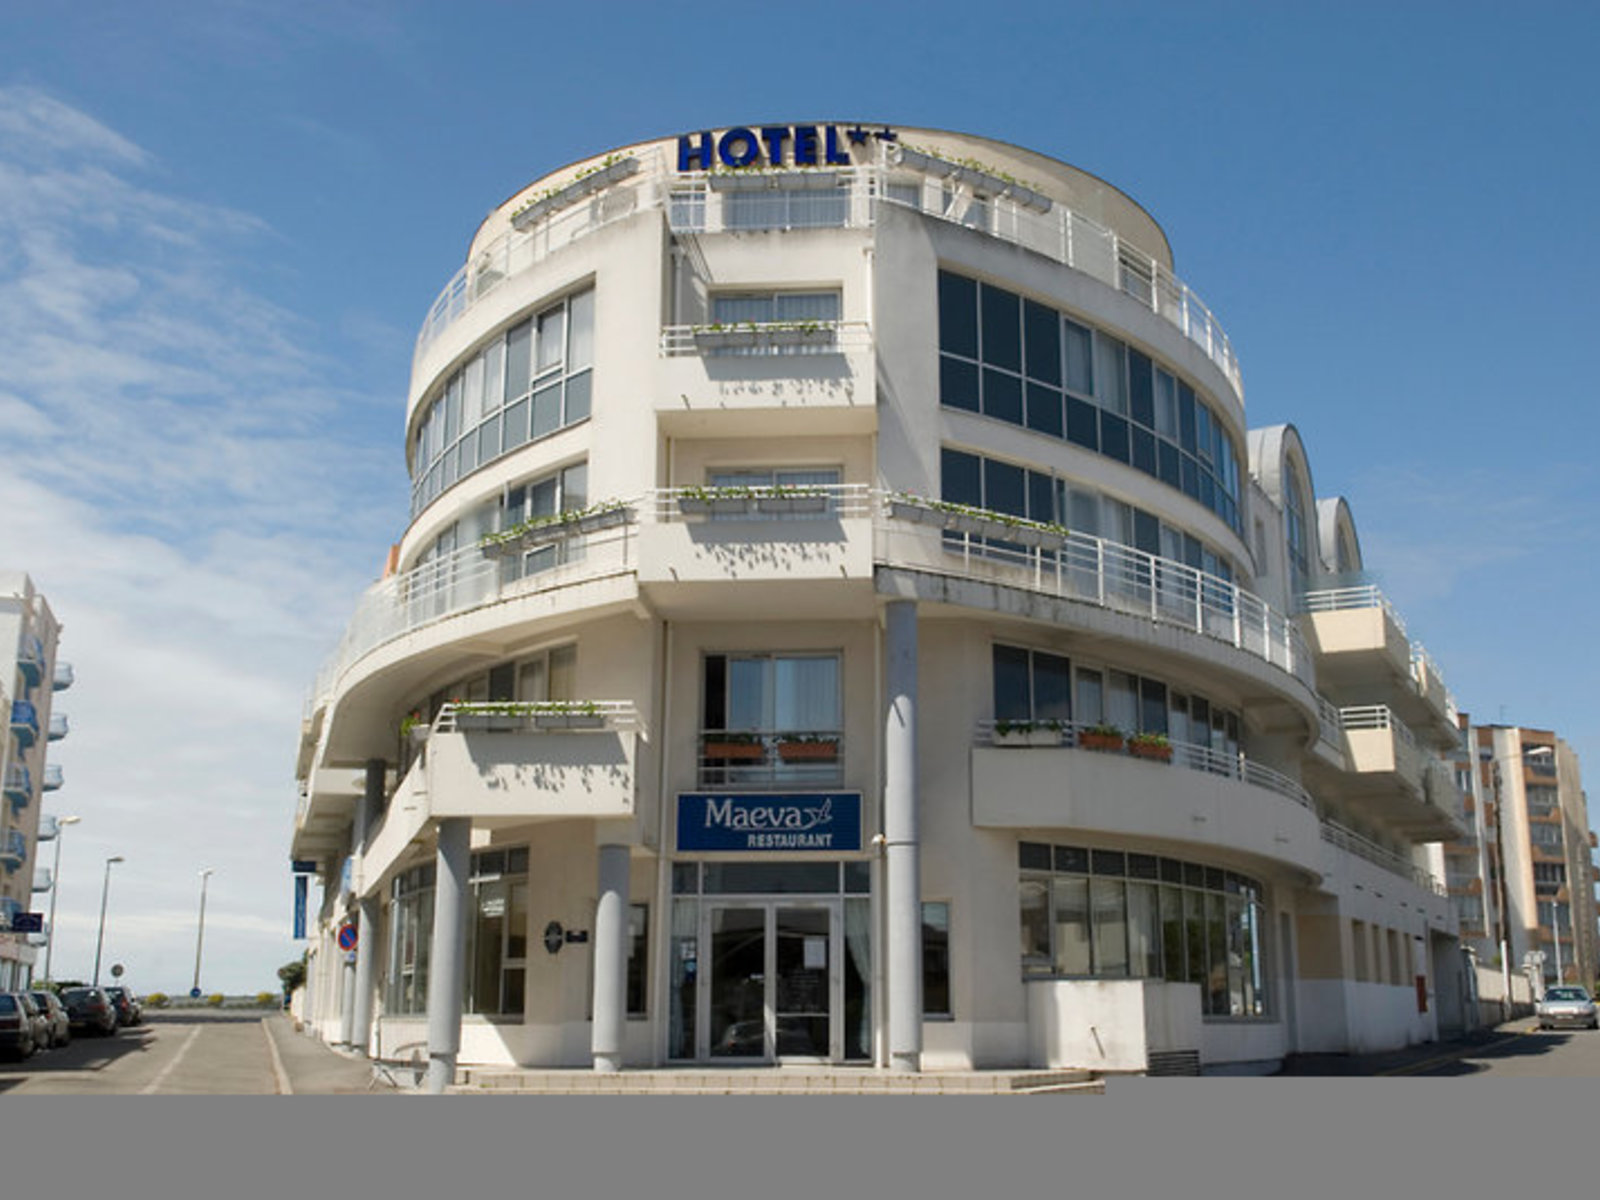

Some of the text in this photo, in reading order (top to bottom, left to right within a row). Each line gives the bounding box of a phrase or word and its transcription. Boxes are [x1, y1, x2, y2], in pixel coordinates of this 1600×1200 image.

[677, 125, 850, 171] HOTEL
[705, 799, 801, 828] Maeva
[747, 833, 832, 848] RESTAURANT
